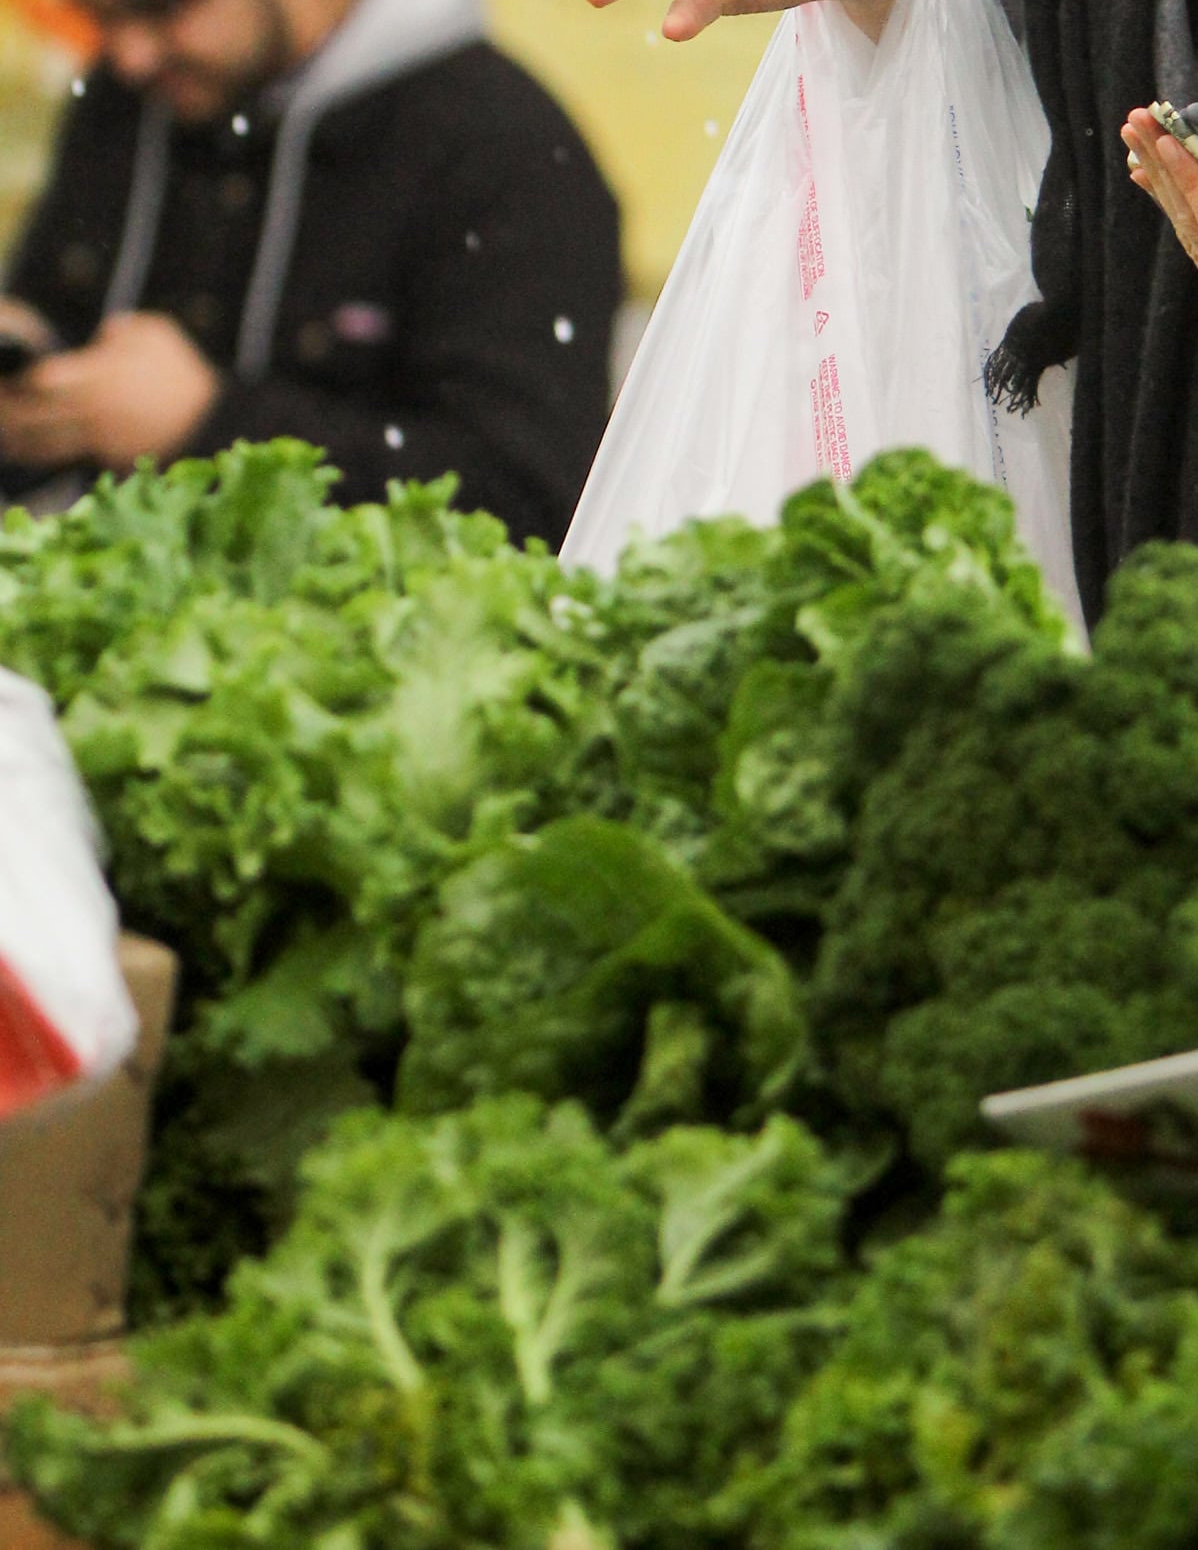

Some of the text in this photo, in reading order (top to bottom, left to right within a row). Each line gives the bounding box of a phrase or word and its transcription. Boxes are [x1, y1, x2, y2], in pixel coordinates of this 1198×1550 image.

[812, 214, 825, 278] SUFFOCATION
[827, 403, 837, 439] PLASTIC
[834, 400, 843, 414] TO
[836, 416, 847, 443] AVOID
